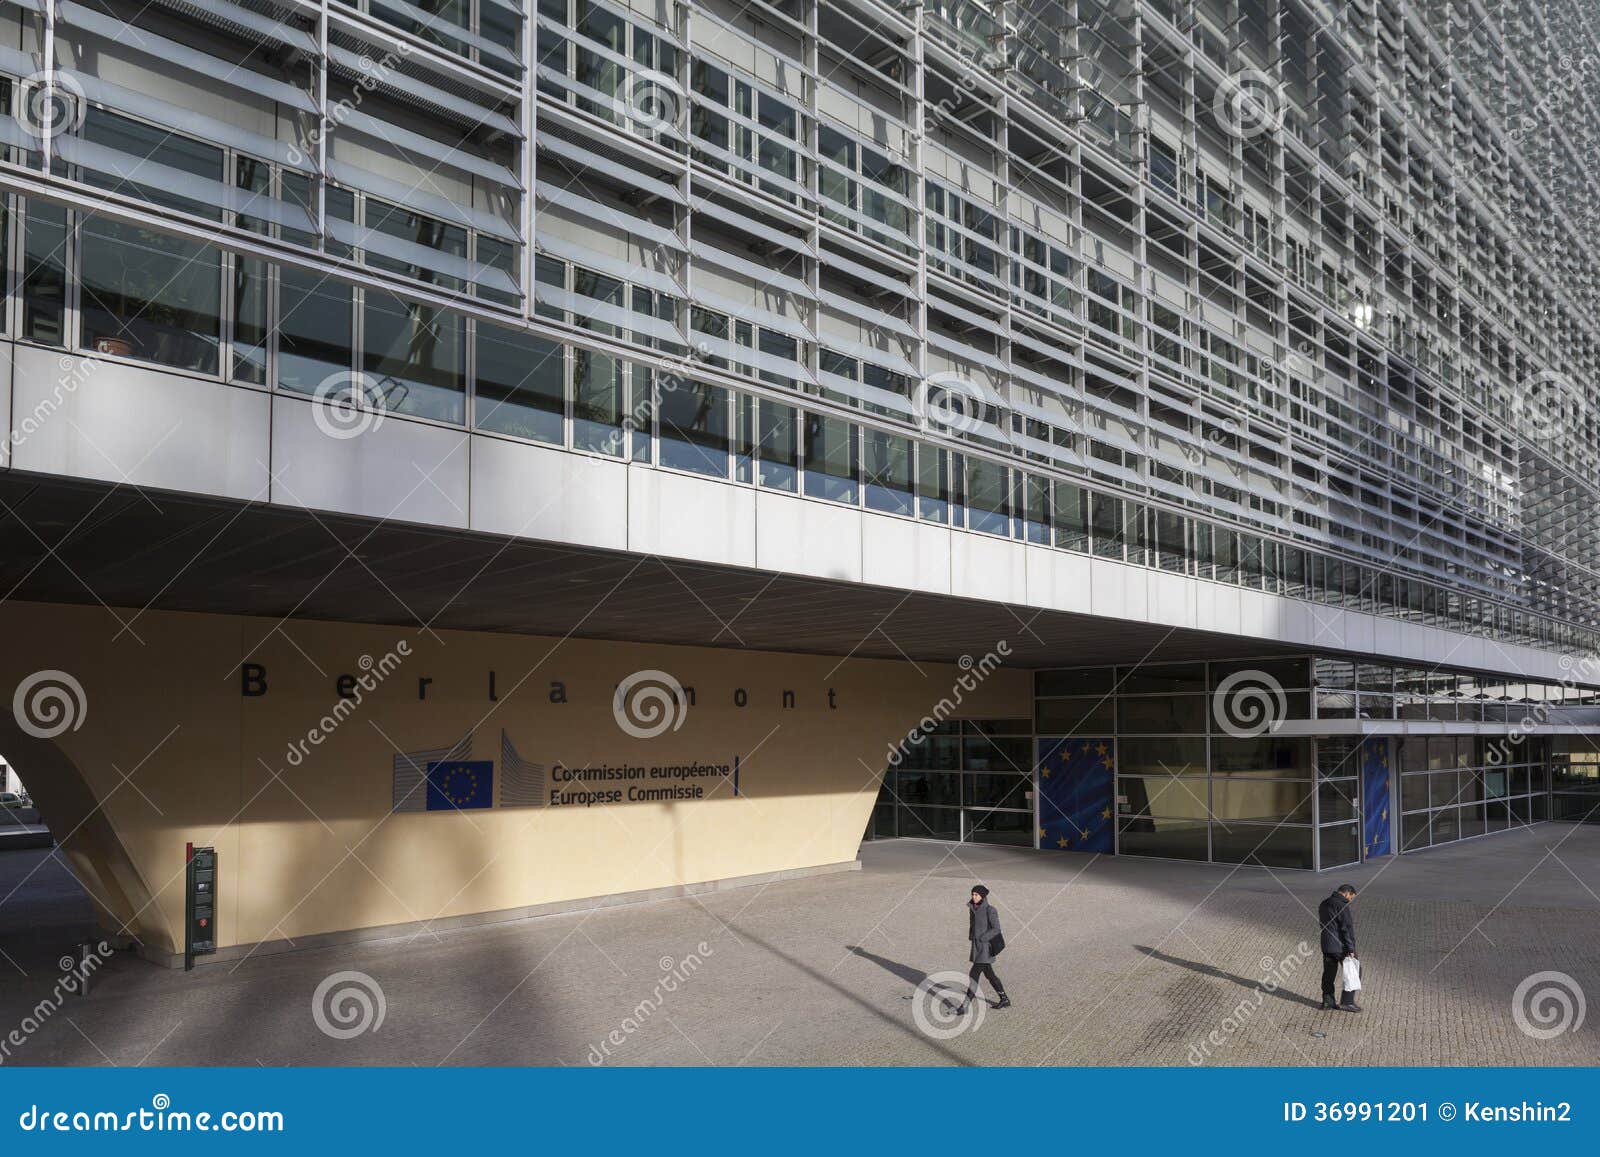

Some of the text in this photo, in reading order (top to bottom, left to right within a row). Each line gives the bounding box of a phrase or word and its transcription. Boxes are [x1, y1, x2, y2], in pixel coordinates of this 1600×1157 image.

[552, 761, 730, 782] Commission européenne
[550, 784, 703, 807] Europese Commissie
